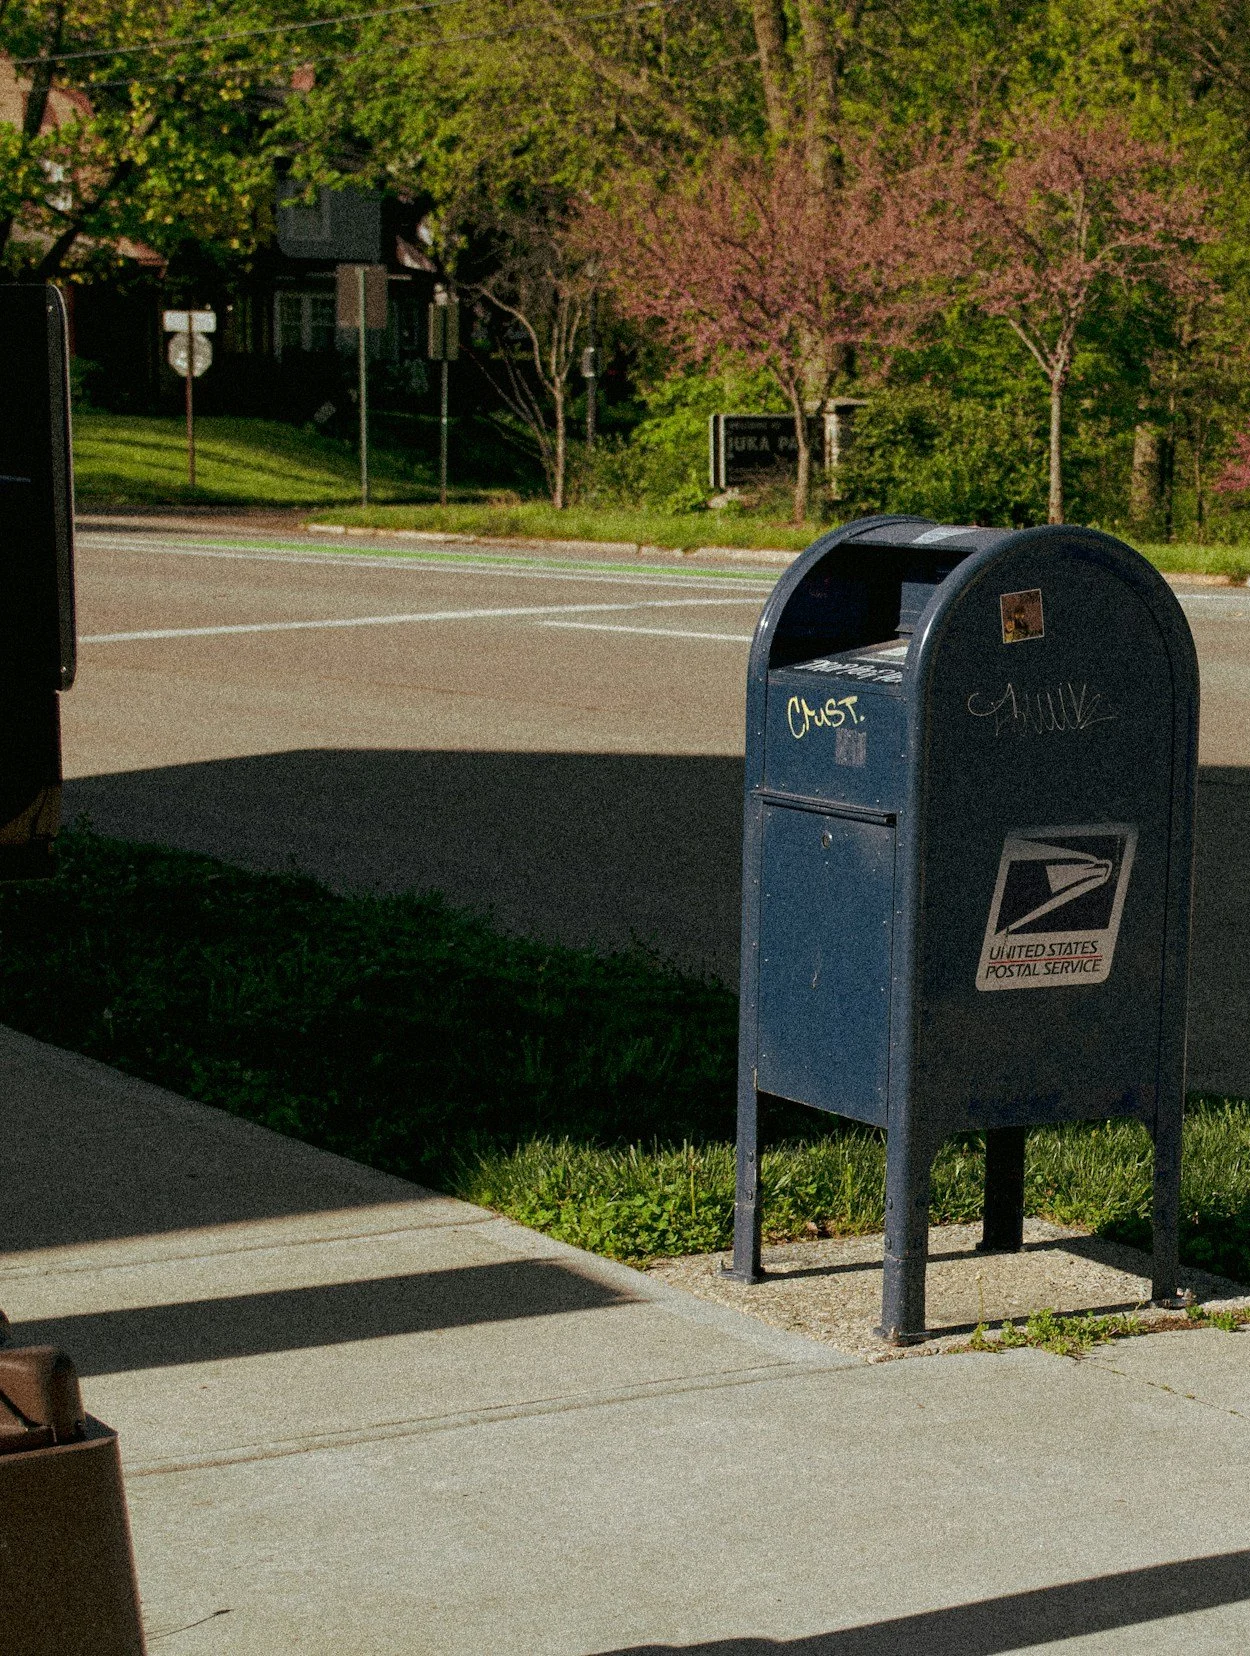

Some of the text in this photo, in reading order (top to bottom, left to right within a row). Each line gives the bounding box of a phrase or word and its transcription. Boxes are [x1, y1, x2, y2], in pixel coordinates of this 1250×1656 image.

[989, 940, 1099, 961] UNITED STATES
[985, 958, 1103, 980] POSTAL SERVICE
